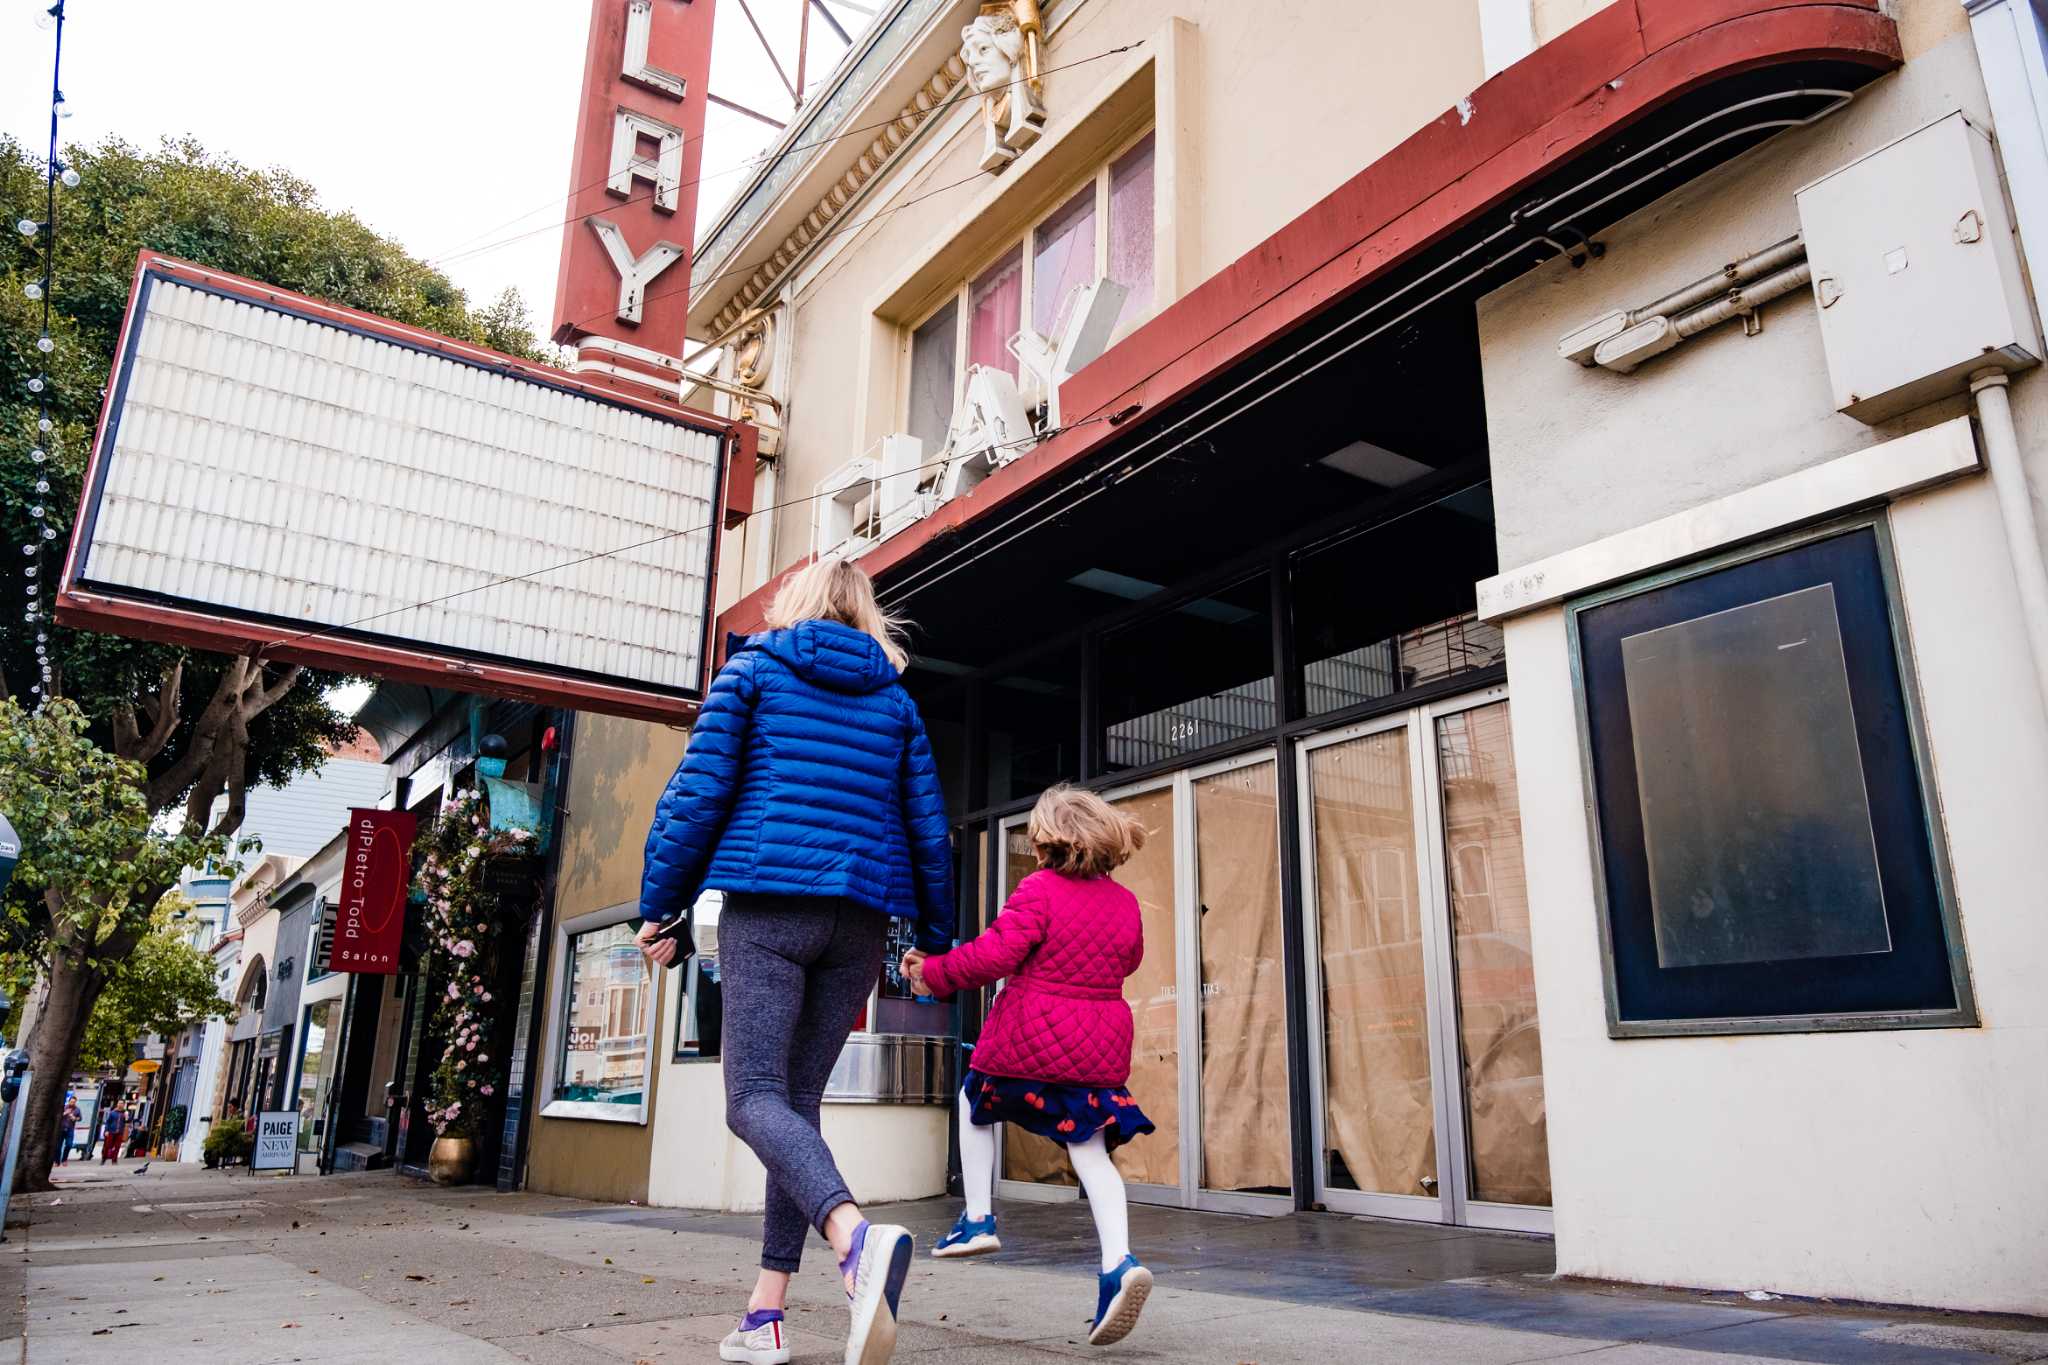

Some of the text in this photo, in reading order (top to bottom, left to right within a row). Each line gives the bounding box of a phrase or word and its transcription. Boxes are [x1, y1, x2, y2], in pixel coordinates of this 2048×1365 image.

[1171, 719, 1199, 741] 2261
[346, 819, 374, 939] diPietro Todd
[342, 950, 389, 963] Salon
[263, 1121, 293, 1136] PAIGE
[262, 1140, 292, 1151] NEW
